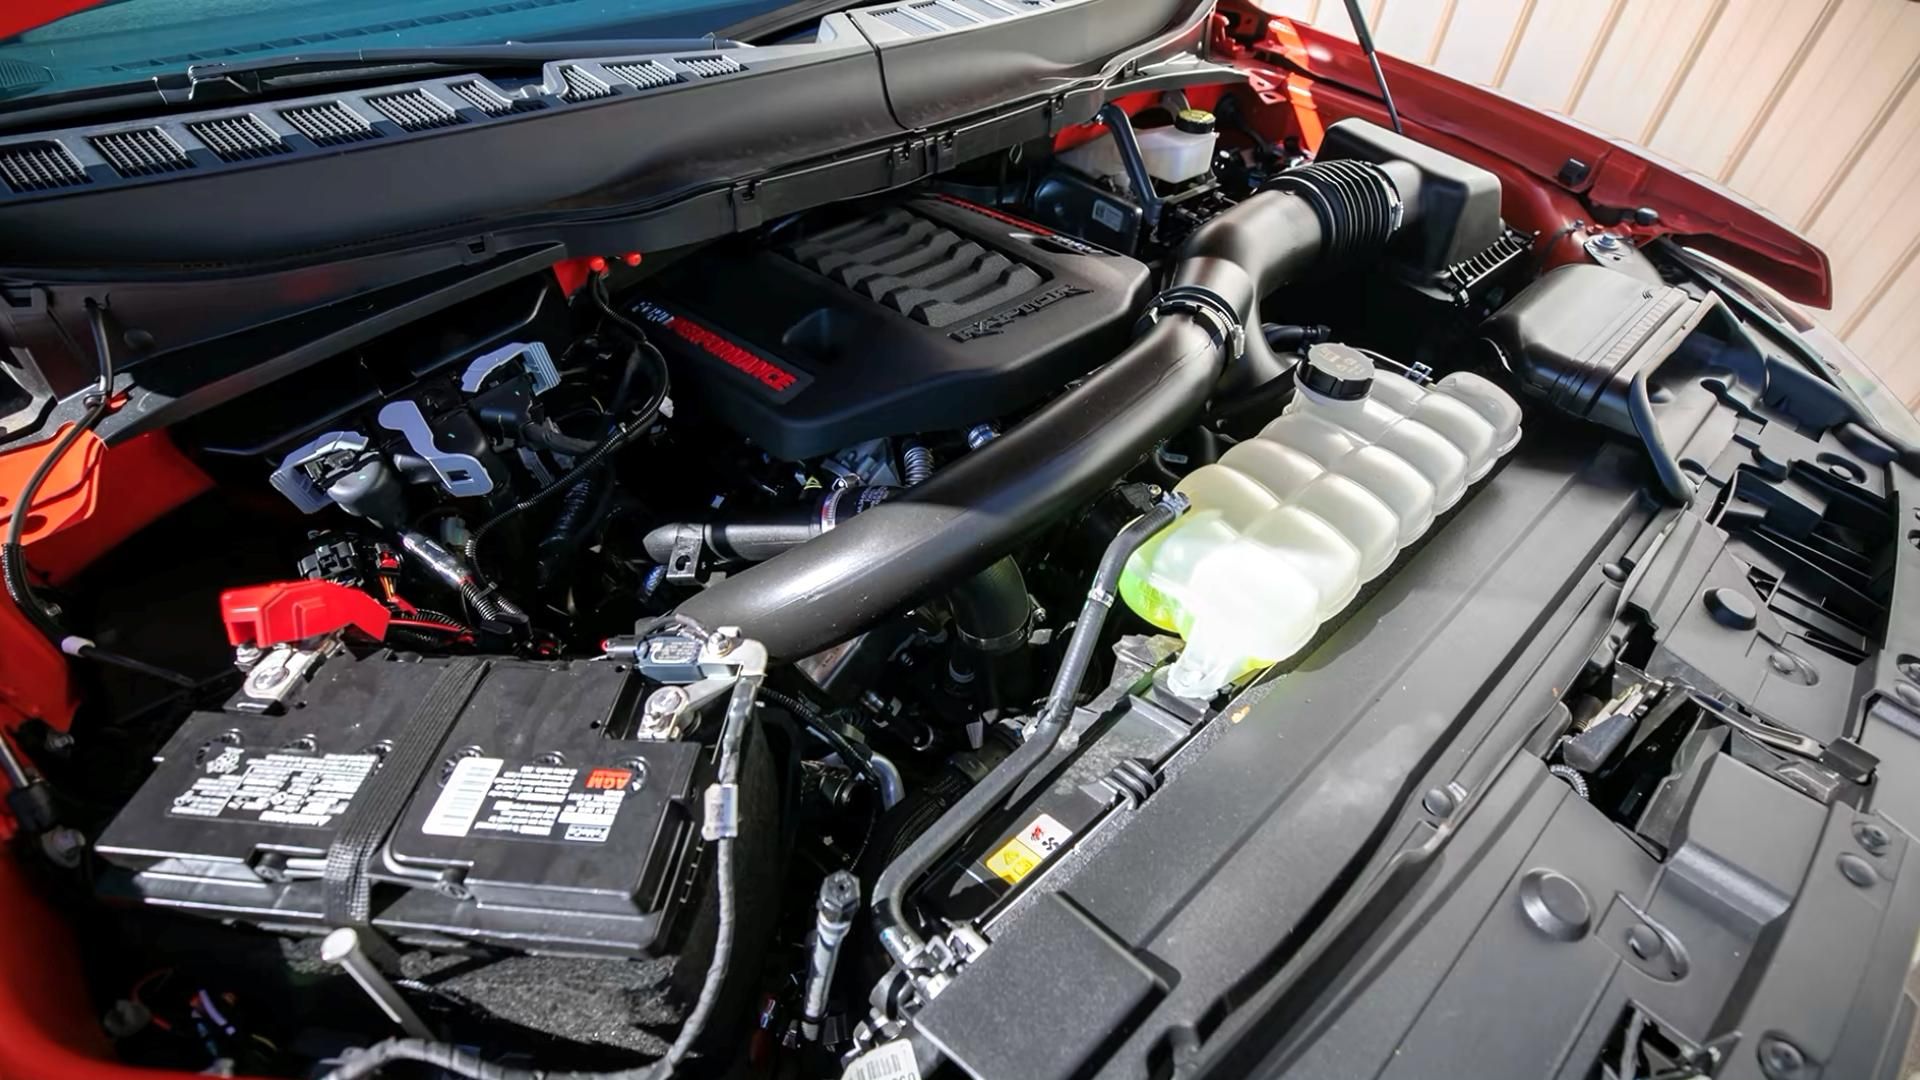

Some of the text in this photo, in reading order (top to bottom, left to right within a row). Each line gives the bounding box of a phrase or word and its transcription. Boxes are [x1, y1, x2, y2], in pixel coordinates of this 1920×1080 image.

[947, 284, 1095, 343] RAPTOR
[666, 316, 797, 392] PERFORMANCE
[586, 774, 630, 789] AGM
